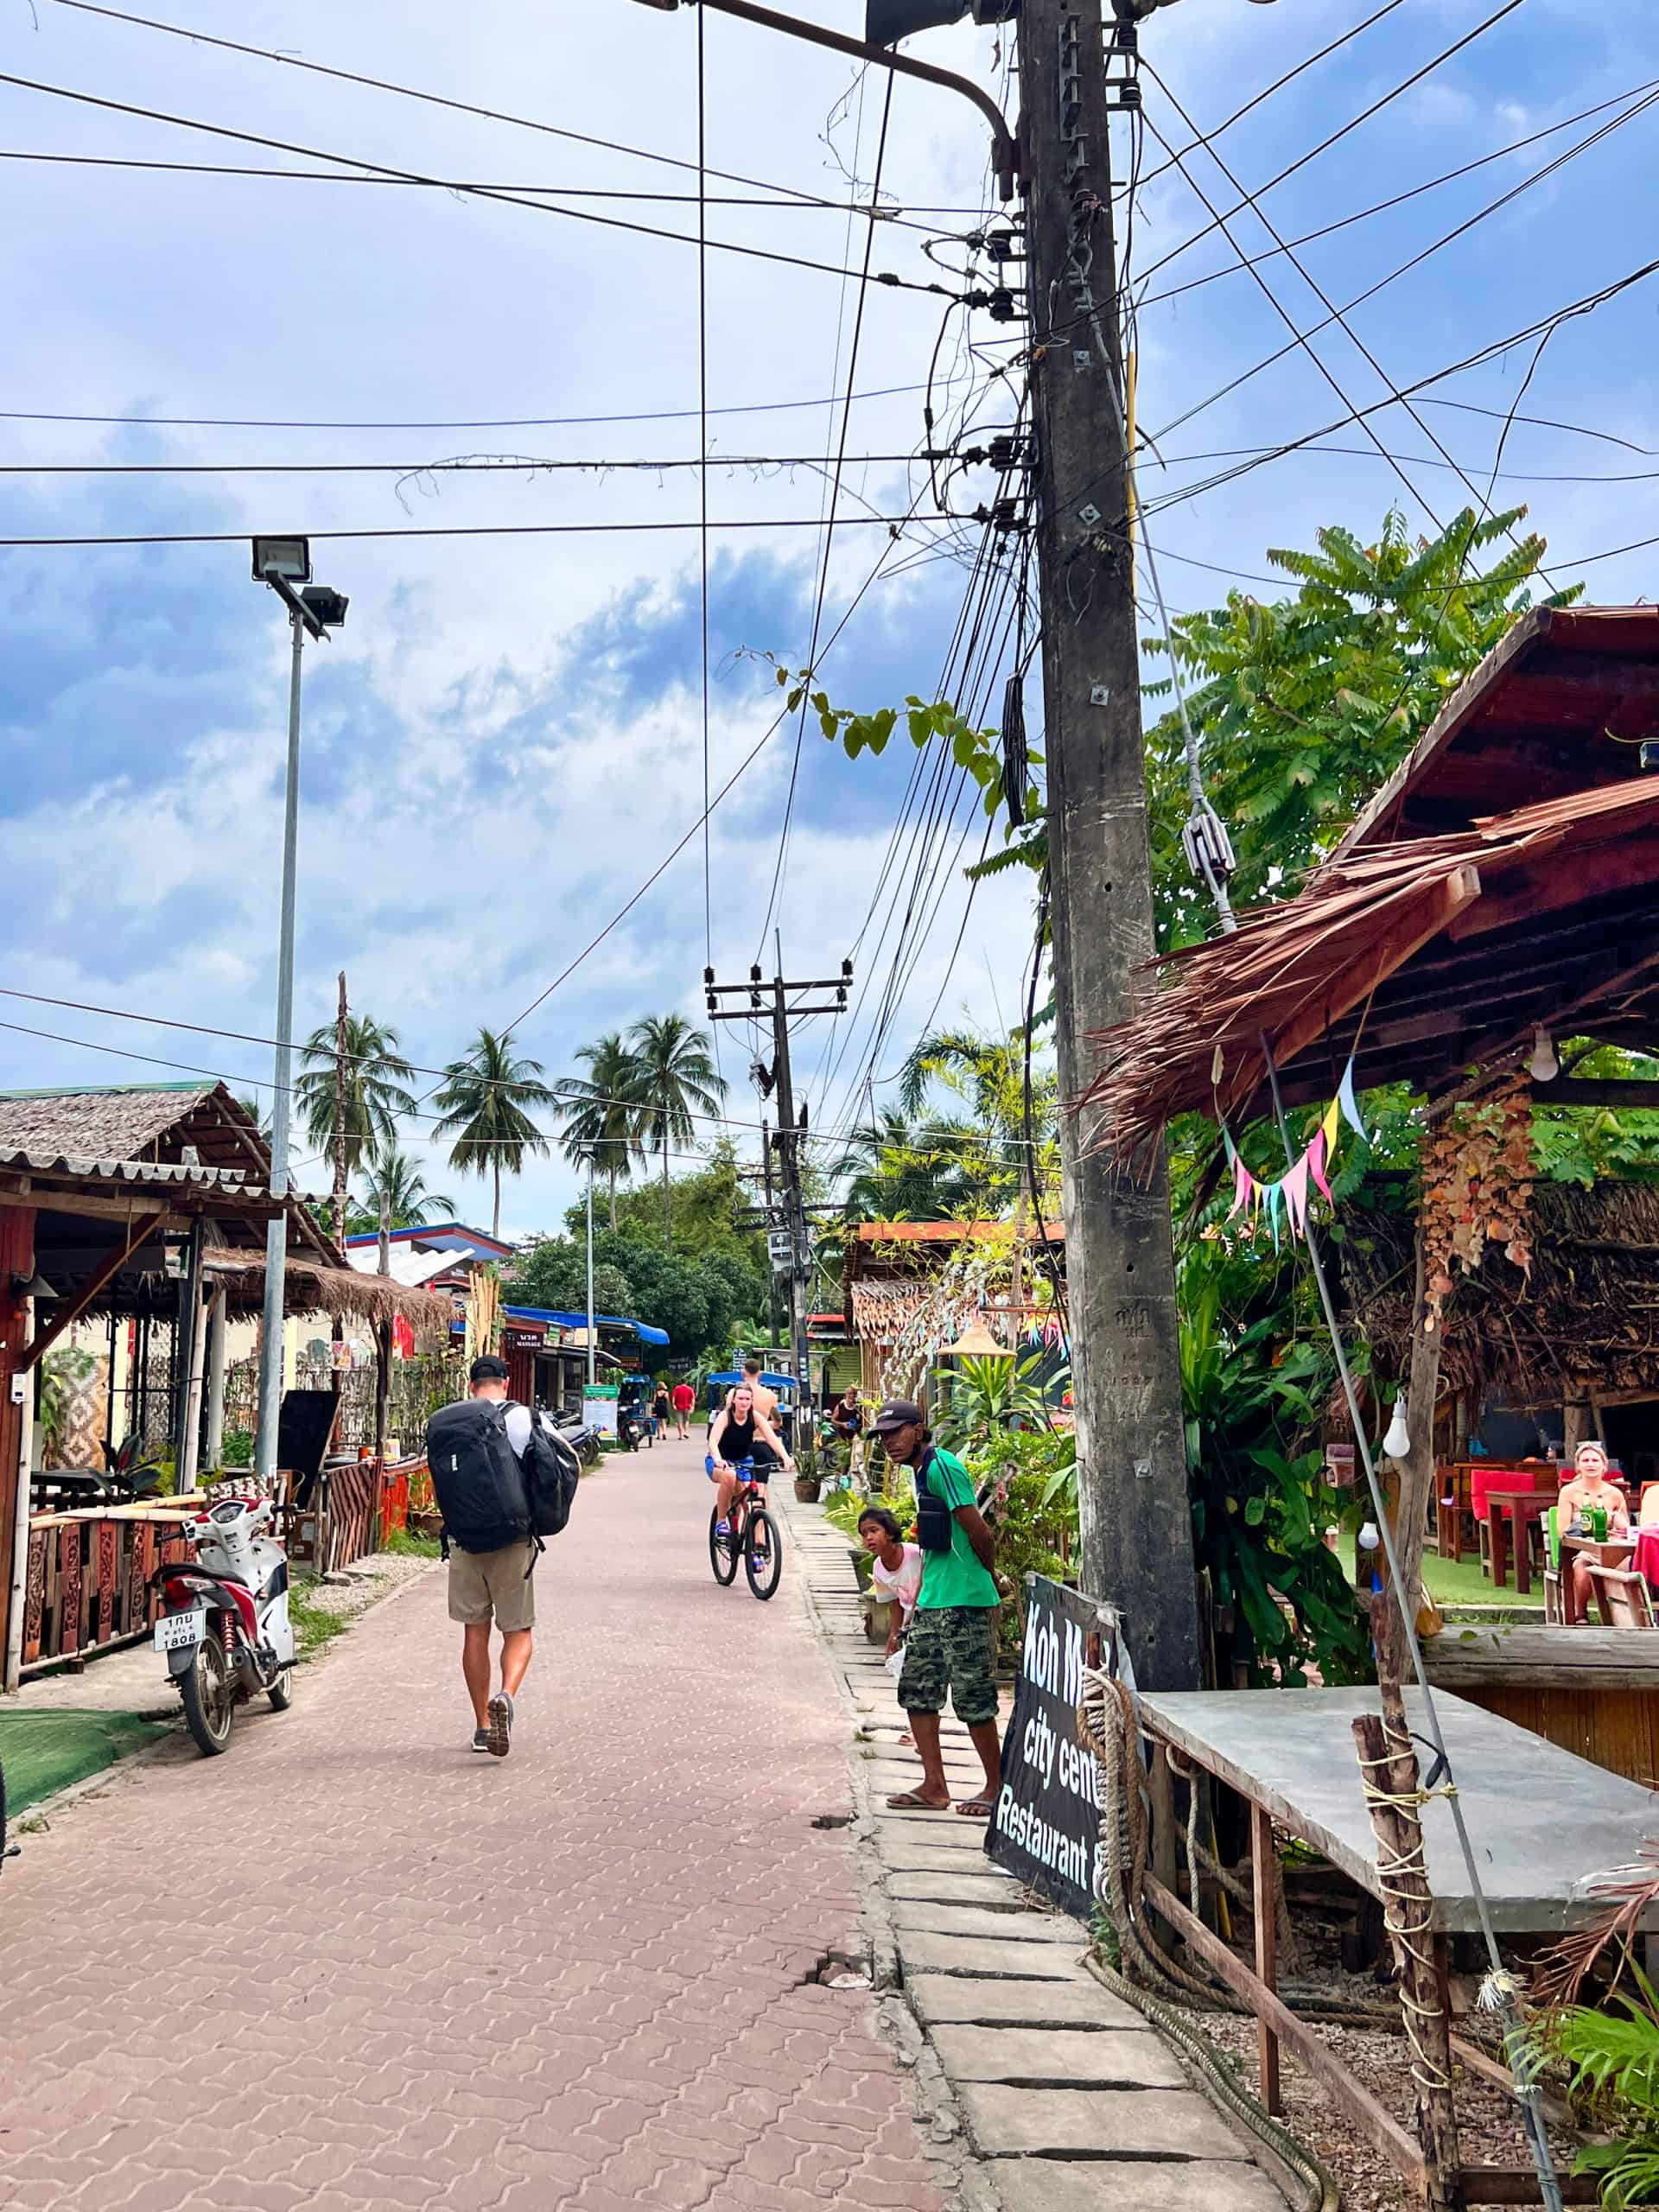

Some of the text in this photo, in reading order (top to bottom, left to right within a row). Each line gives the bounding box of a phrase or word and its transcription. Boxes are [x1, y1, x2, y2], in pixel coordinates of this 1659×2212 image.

[164, 1633, 195, 1649] 1808
[1023, 1600, 1058, 1697] Koh
[1023, 1705, 1105, 1813] city cent
[996, 1783, 1088, 1891] Restaurant
